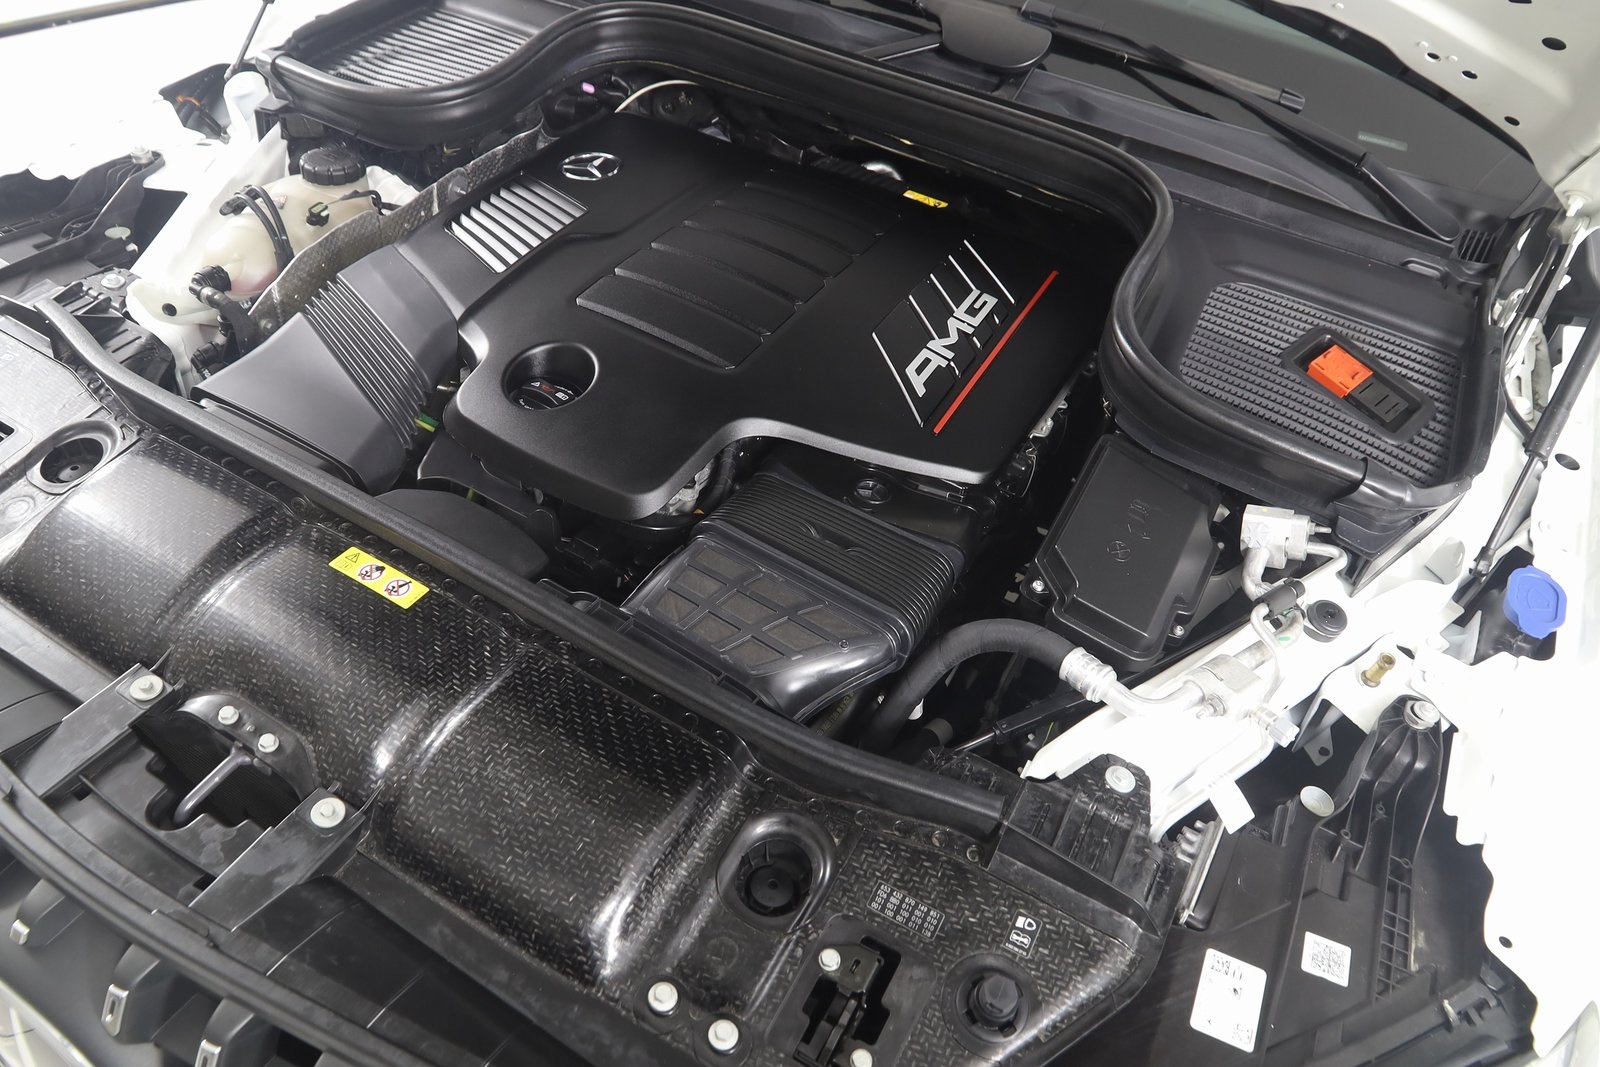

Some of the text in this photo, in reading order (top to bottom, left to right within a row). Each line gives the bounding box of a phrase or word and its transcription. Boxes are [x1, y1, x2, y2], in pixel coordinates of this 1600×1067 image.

[904, 288, 999, 398] AMG
[871, 902, 881, 910] 001
[884, 909, 894, 917] 100
[896, 915, 906, 923] 001
[908, 922, 918, 930] 011
[887, 903, 897, 911] 001
[911, 916, 922, 924] 010
[924, 922, 934, 931] 010
[902, 903, 912, 912] 011
[914, 910, 924, 918] 001
[927, 916, 937, 925] 010
